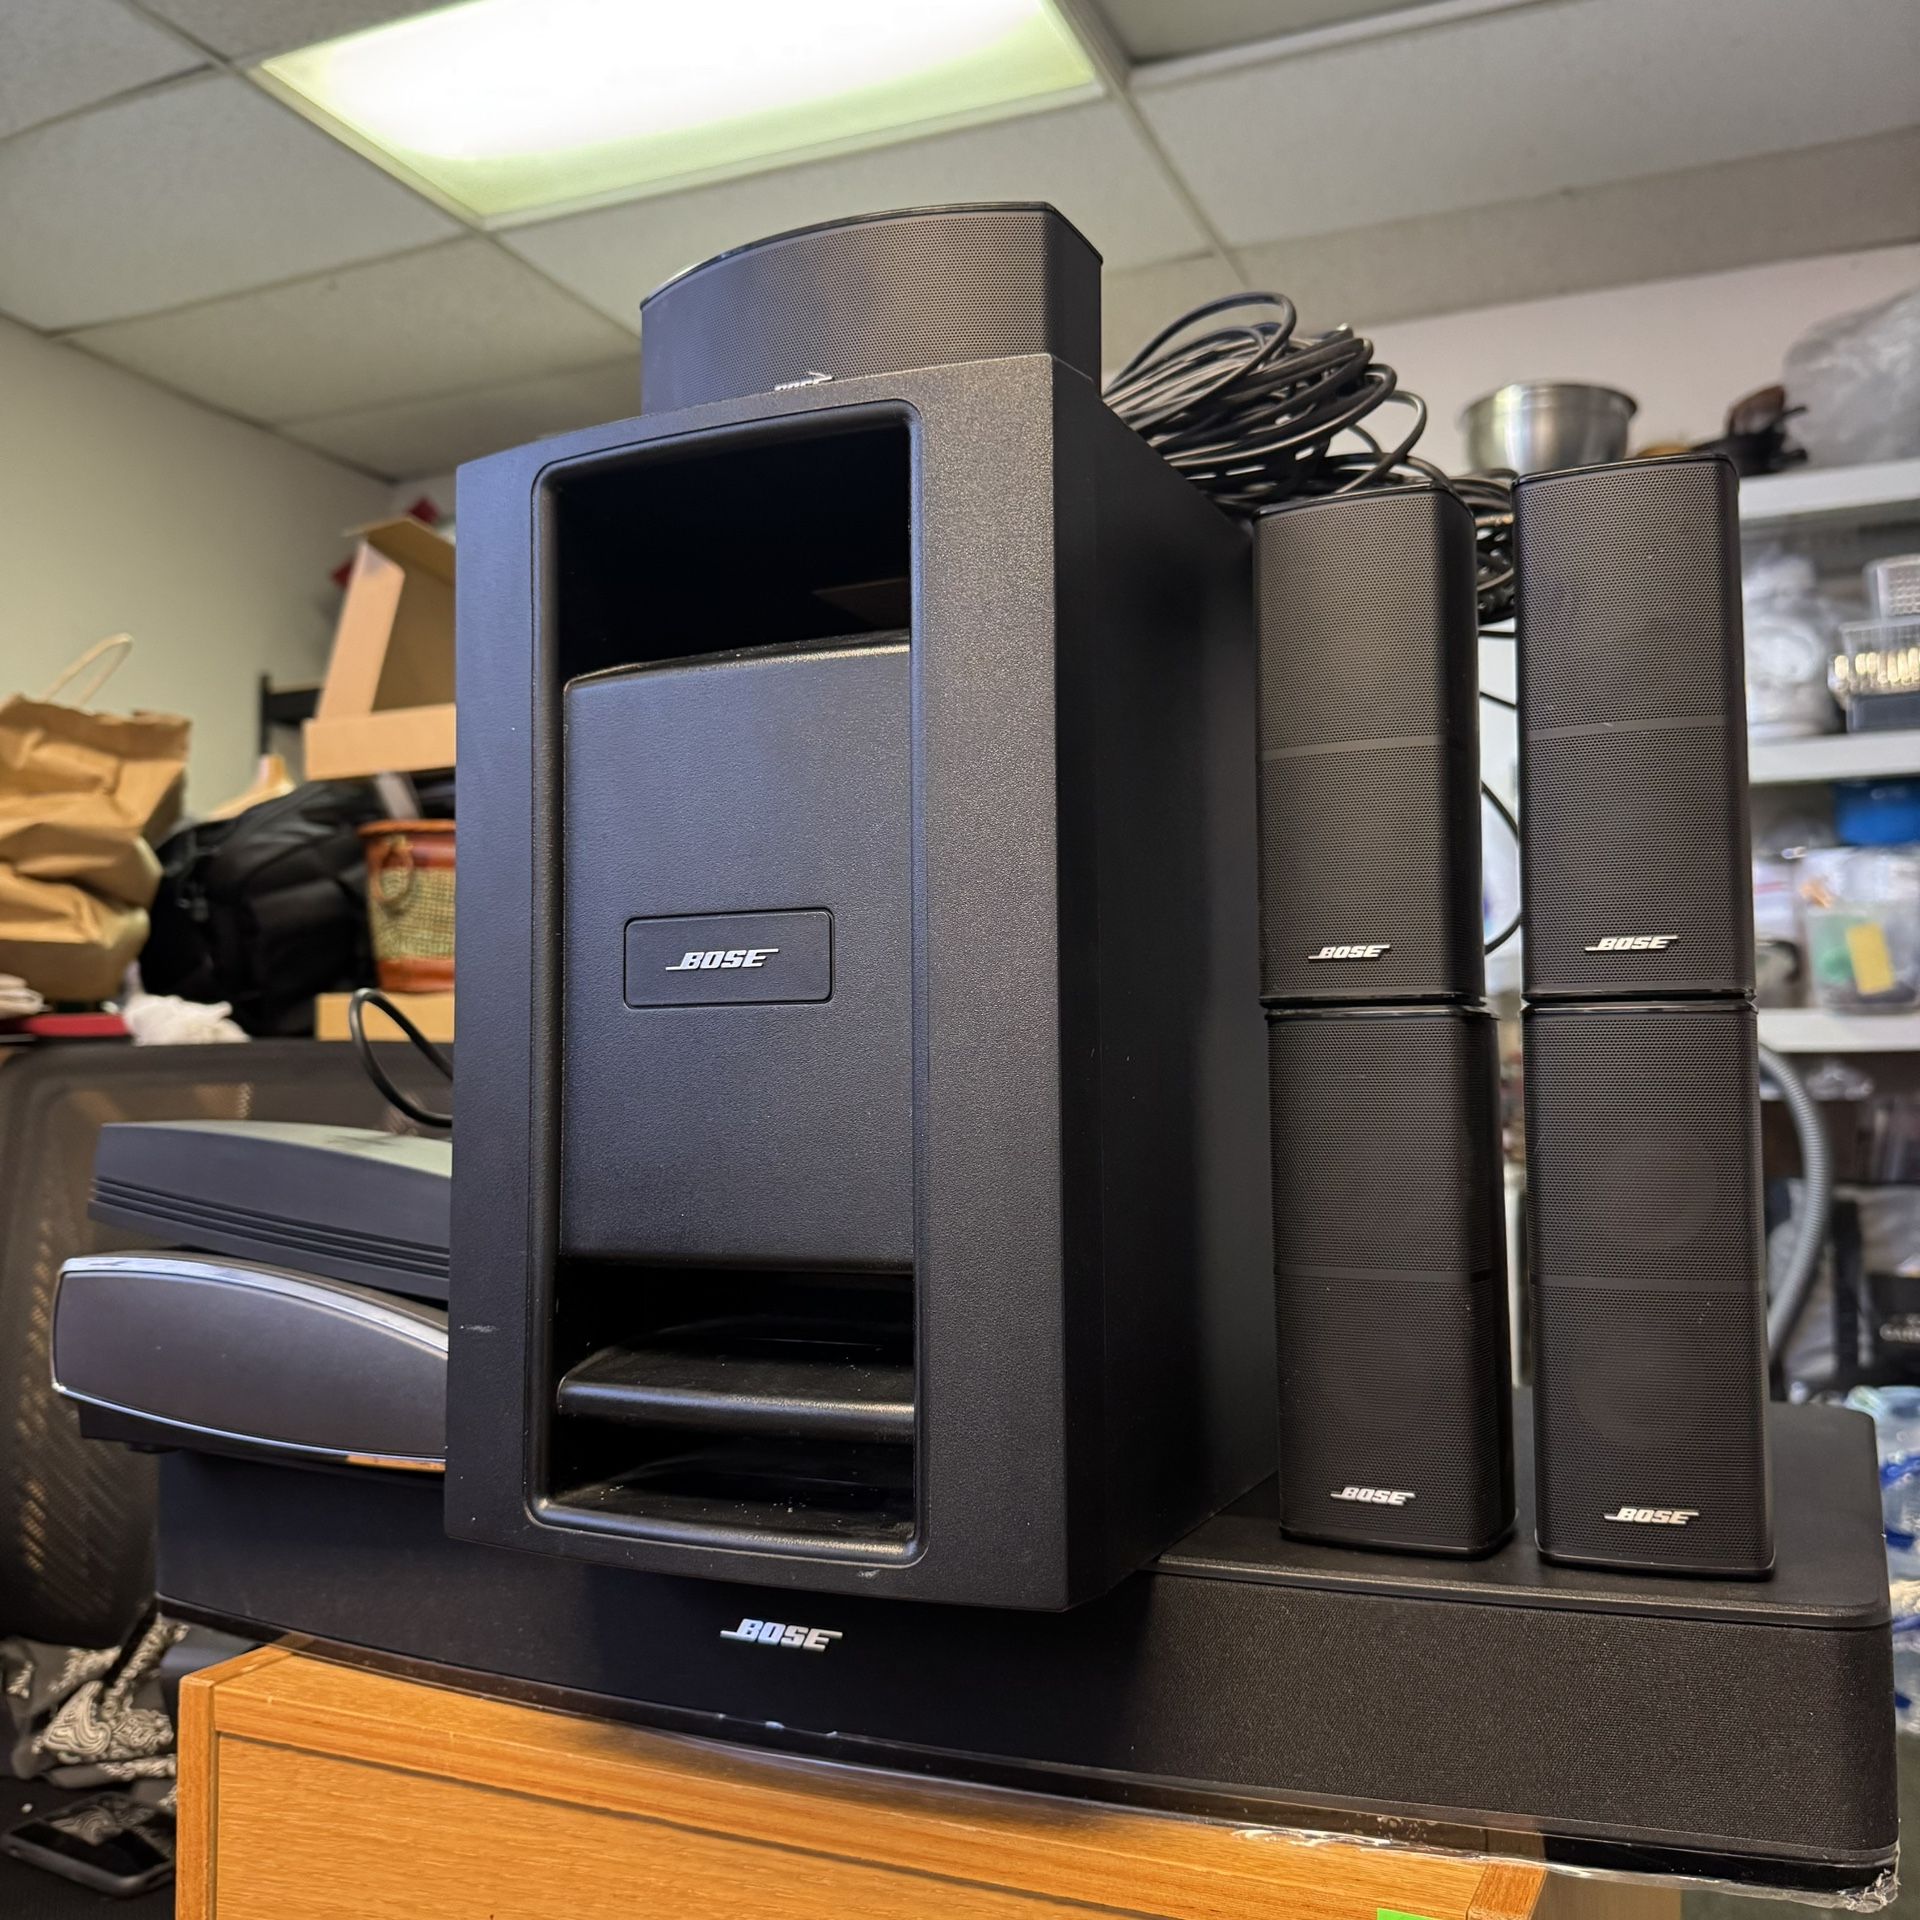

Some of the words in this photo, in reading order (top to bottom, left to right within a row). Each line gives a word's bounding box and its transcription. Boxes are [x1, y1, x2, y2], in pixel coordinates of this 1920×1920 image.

[1308, 944, 1390, 960] BOSE
[1585, 936, 1677, 951] BOSE
[665, 948, 779, 971] BOSE
[1330, 1486, 1416, 1506] BOSE
[1603, 1507, 1699, 1525] BOSE
[720, 1618, 843, 1652] BOSE
